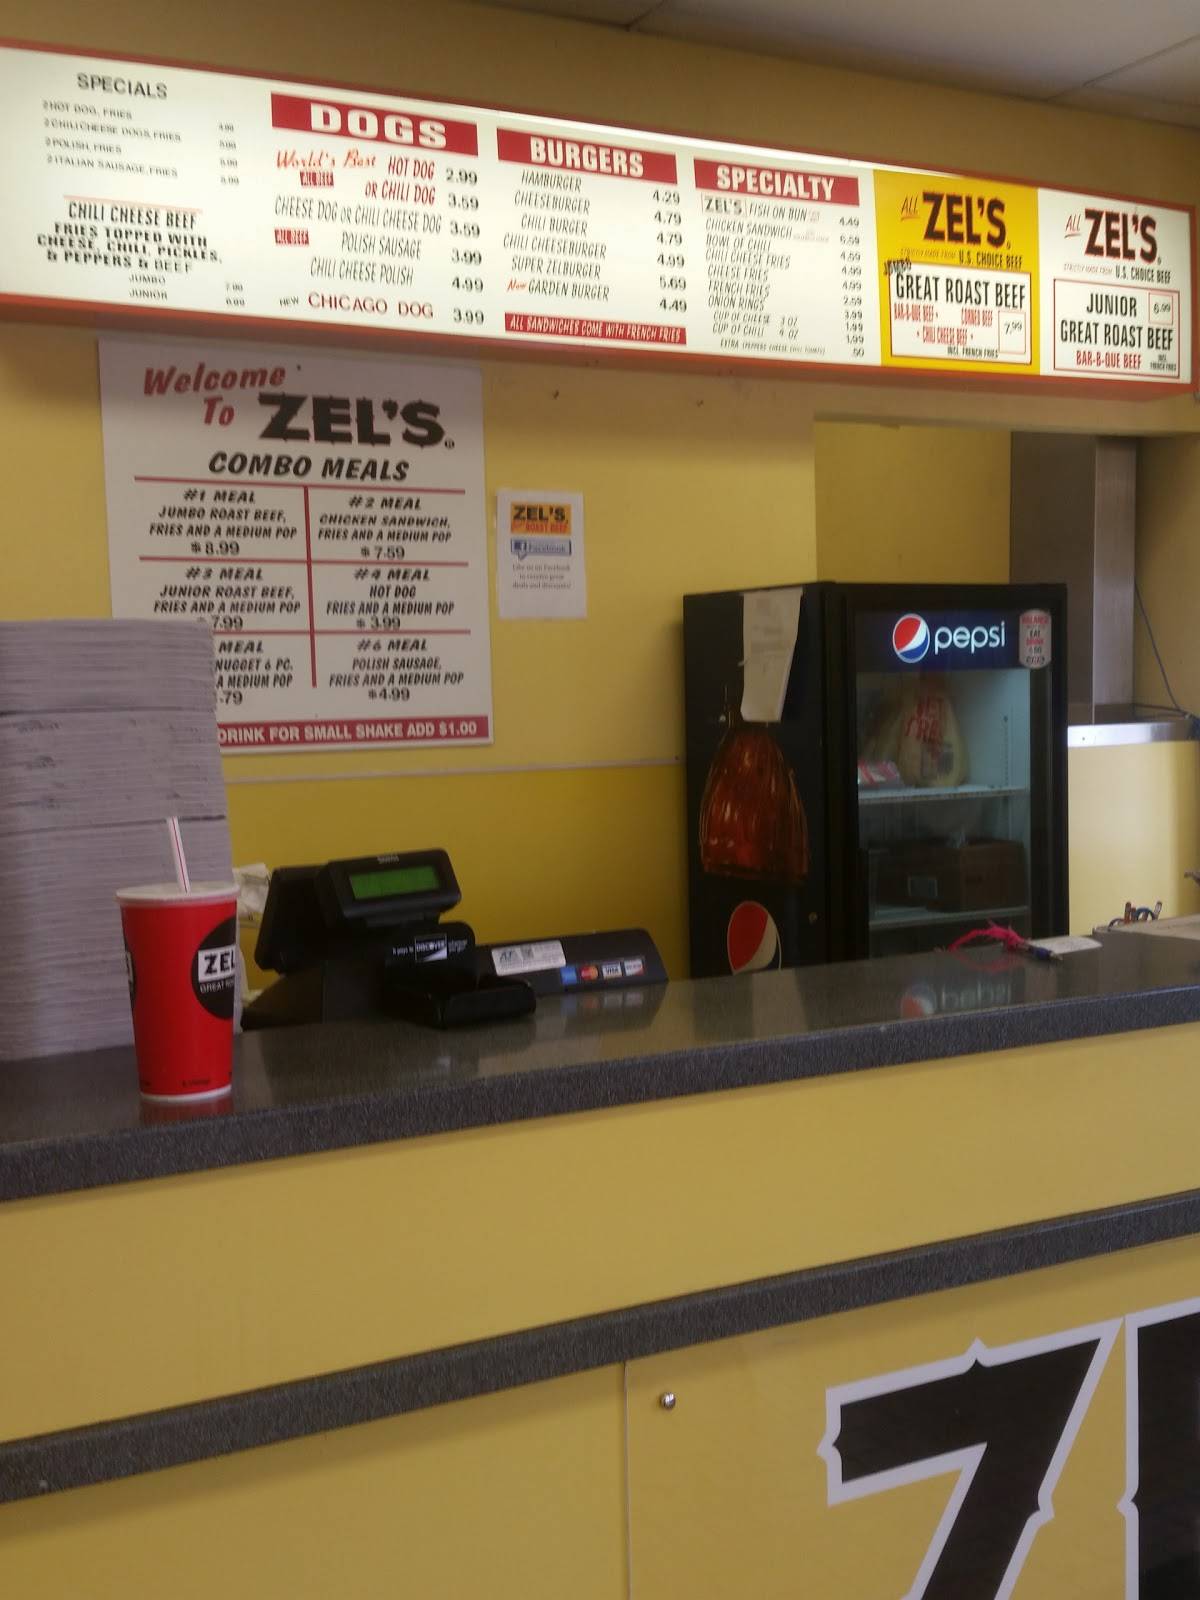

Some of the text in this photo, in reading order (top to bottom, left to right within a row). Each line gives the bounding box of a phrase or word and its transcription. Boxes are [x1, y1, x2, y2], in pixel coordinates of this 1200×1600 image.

[77, 72, 167, 99] SPECIALS
[310, 102, 447, 149] DOGS
[530, 136, 644, 177] BURGERS
[387, 155, 410, 177] HOT
[413, 159, 436, 180] DOG
[446, 167, 478, 186] 2.99
[716, 164, 835, 201] SPECIALTY
[364, 180, 479, 211] OR CHILI DOG 3.59
[521, 168, 681, 205] HAMBURGER 4.29
[69, 201, 197, 230] CHILI CHEESE BEEF
[275, 195, 480, 239] CHEESE DOG CHILI CHEESE DOG 3.59
[514, 189, 682, 226] CHEESEBURGER 4.79
[922, 190, 1007, 249] ZEL'S
[54, 222, 208, 249] FRIES TOPPED WITH
[521, 213, 682, 246] CHILI BURGER 4.79
[705, 217, 744, 233] CHICKEN
[747, 223, 793, 240] SANDWICH
[1065, 208, 1158, 263] ALL ZEL'S
[341, 231, 482, 266] POLISH SAUSAGE 3.99
[503, 232, 685, 268] CHILI CHEESEBURGER 4.99
[976, 251, 1003, 269] CHOICE
[1005, 254, 1023, 271] BEEF
[310, 256, 484, 293] CHILI CHEESE POLISH 4.99
[511, 254, 544, 274] SUPER
[1130, 267, 1154, 283] CHOICE
[1156, 269, 1171, 285] BEEF
[129, 273, 166, 285] JUMBO
[896, 273, 1026, 309] GREAT ROAST BEEF
[129, 289, 168, 301] JUNIOR
[308, 291, 485, 325] CHICAGO DOG 3.99
[528, 279, 688, 313] GARDEN BURGER 4.49
[1086, 293, 1138, 317] JUNIOR
[510, 314, 681, 343] ALL SANDWICHES COME WITH FRENCH FRIES
[1060, 319, 1174, 351] GREAT ROAST BEEF
[1076, 350, 1121, 369] BAR-B-QUE
[1123, 353, 1142, 370] BEEF
[143, 361, 287, 397] Welcome
[203, 391, 446, 449] To ZEL'S
[208, 451, 410, 482] COMBO MEALS
[213, 489, 256, 503] MEAL
[380, 496, 422, 511] MEAL
[158, 505, 287, 523] JUMBO ROAST BEEF,
[319, 513, 451, 529] CHICKEN SANDWICH,
[513, 504, 566, 522] ZEL'S
[149, 523, 298, 540] FRIES AND A MEDIUM POP
[219, 567, 263, 581] MEAL
[387, 568, 431, 582] MEAL
[159, 584, 295, 600] JUNIOR ROAST BEEF,
[369, 584, 417, 599] HOT DOG
[153, 600, 301, 614] FRIES AND A MEDIUM POP
[326, 601, 455, 616] FRIES AND A MEDIUM POP
[218, 640, 264, 654] MEAL
[387, 639, 429, 652] MEAL
[934, 620, 1006, 656] pepsi
[215, 658, 261, 672] NUGGET
[352, 656, 442, 671] POLISH SAUSAGE,
[217, 720, 478, 745] DRINK FOR SMALL SHAKE ADD $1.00
